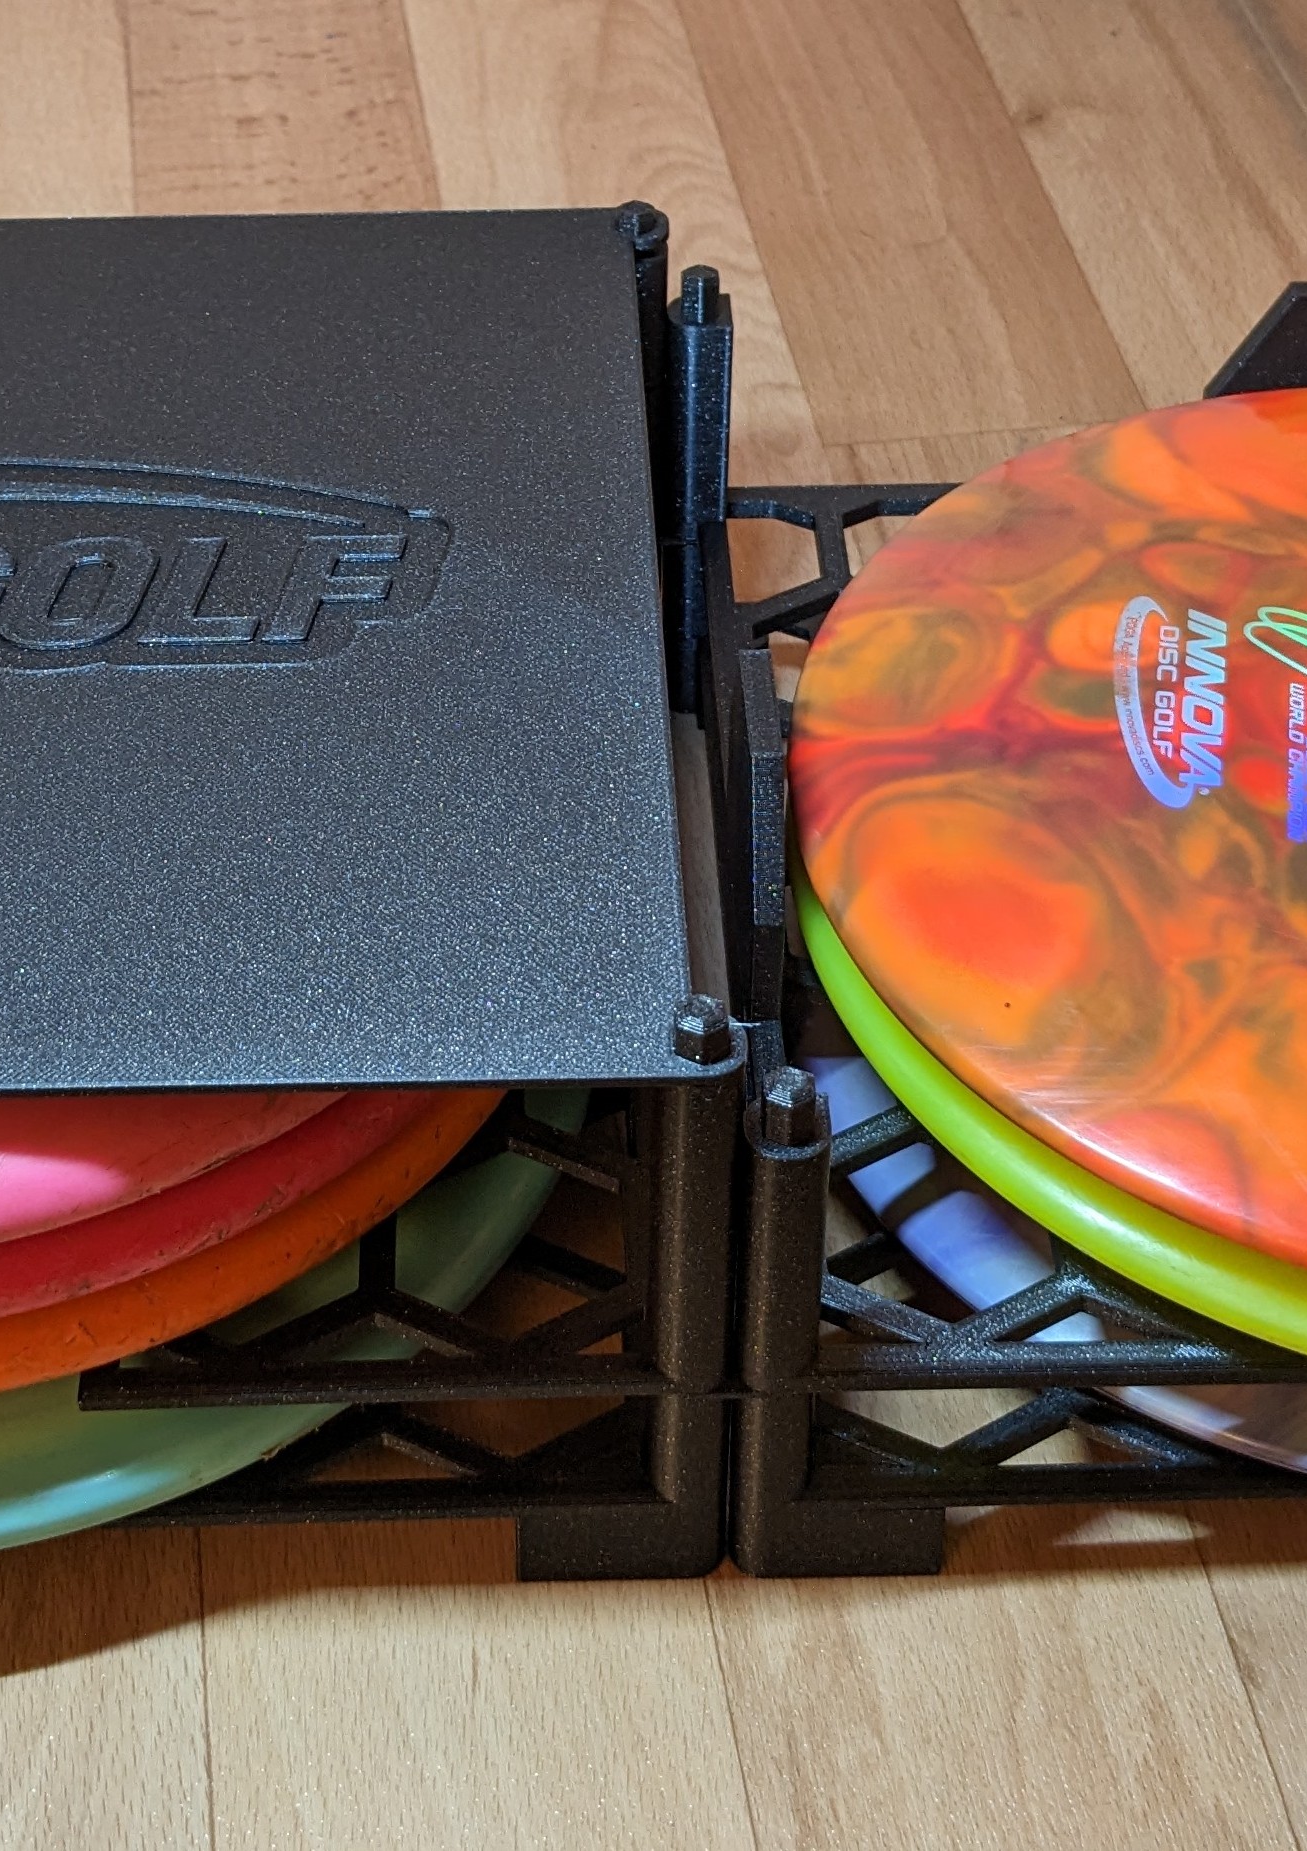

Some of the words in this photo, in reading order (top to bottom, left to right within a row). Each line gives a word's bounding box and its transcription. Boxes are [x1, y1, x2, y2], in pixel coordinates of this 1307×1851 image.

[1156, 625, 1180, 682] DISC
[1152, 690, 1176, 759] GOLF
[1178, 608, 1228, 787] INNOVA
[1289, 683, 1306, 744] WORLD
[1287, 750, 1306, 843] CHAMPION
